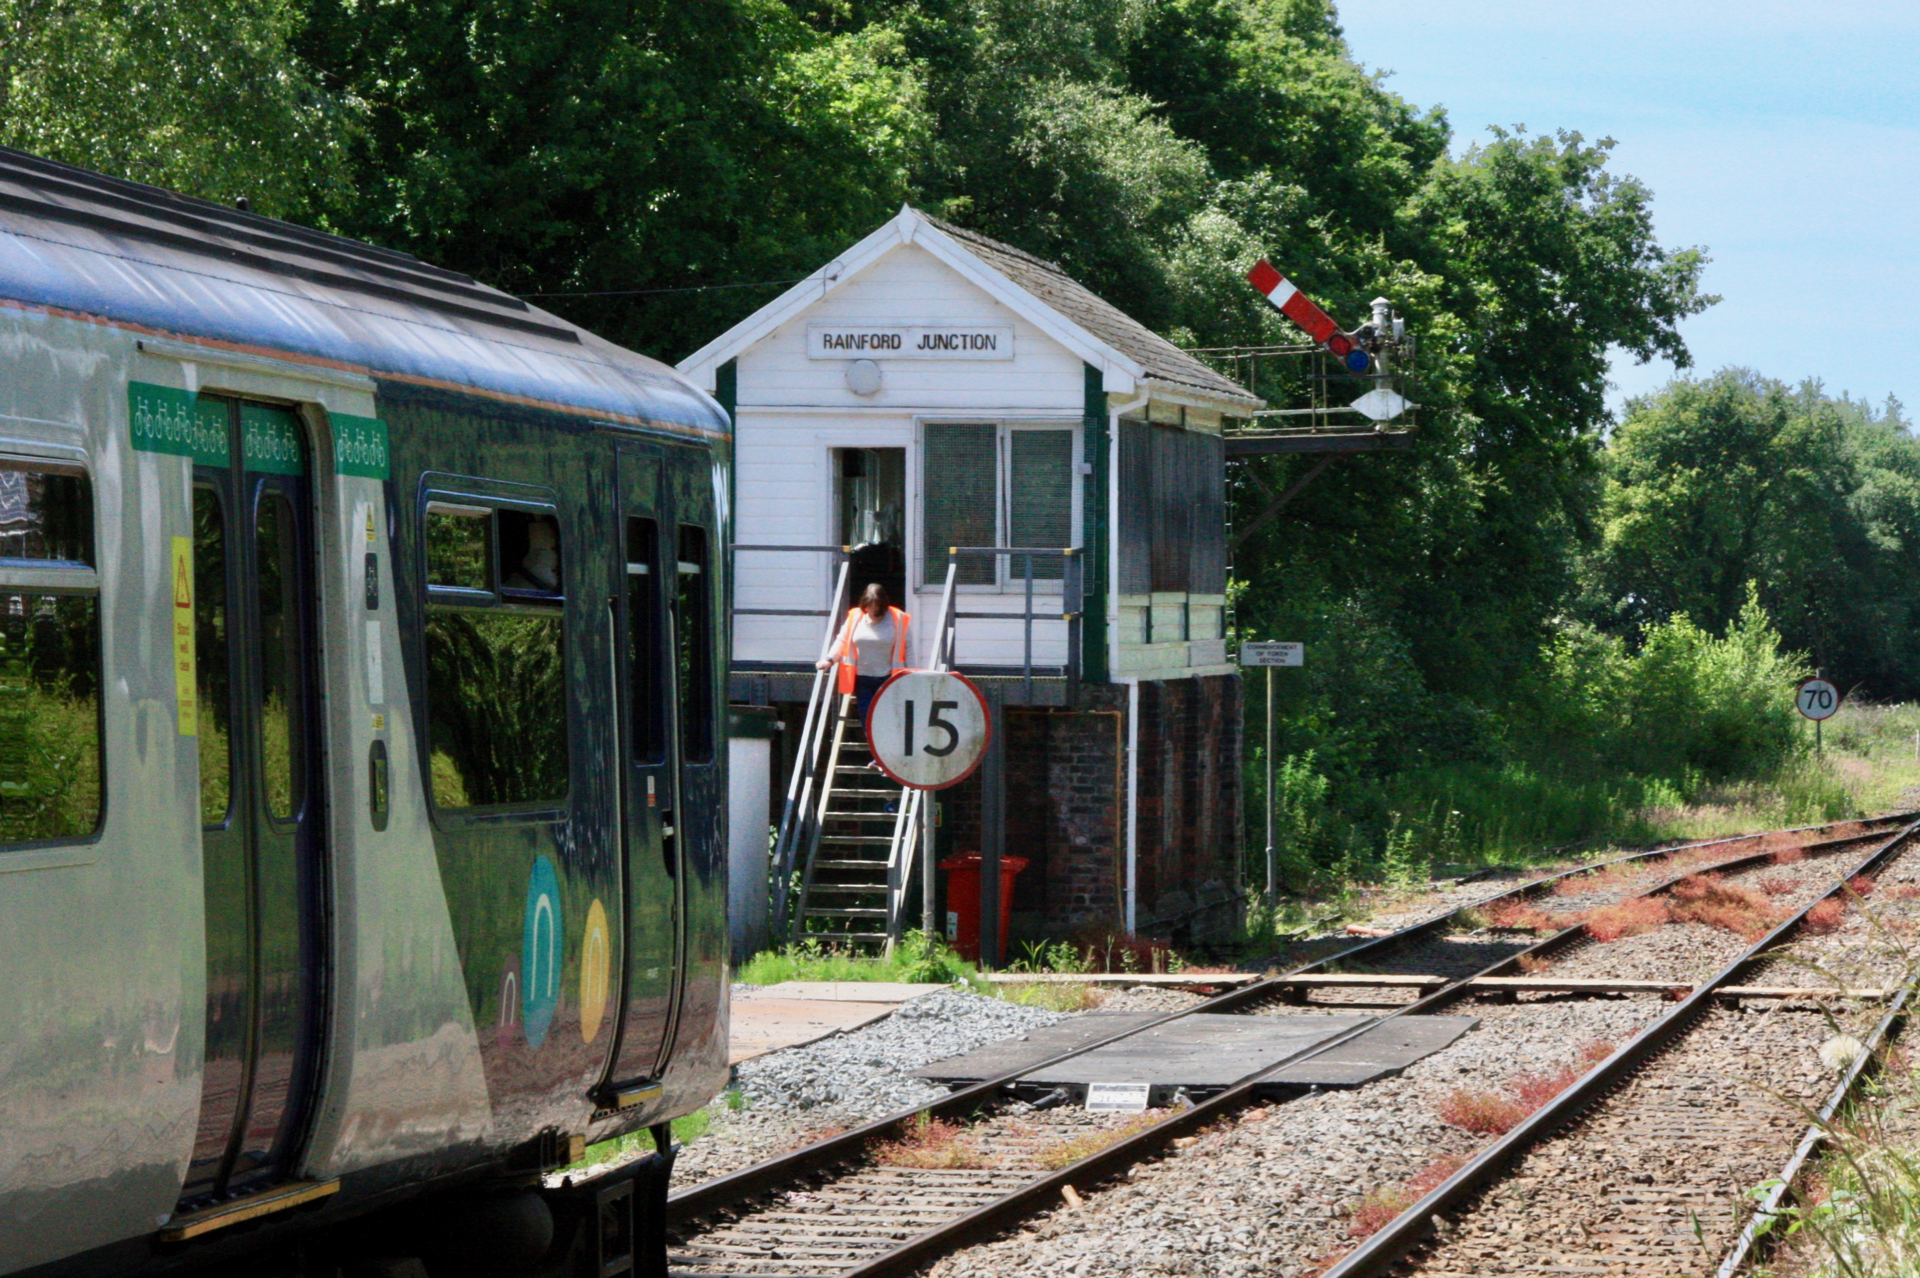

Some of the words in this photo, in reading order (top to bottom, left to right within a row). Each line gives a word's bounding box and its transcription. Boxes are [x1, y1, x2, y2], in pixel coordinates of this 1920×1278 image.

[823, 333, 902, 350] RAINFORD
[917, 333, 997, 350] JUNCTION
[1804, 690, 1833, 710] 70
[904, 699, 960, 758] 15
